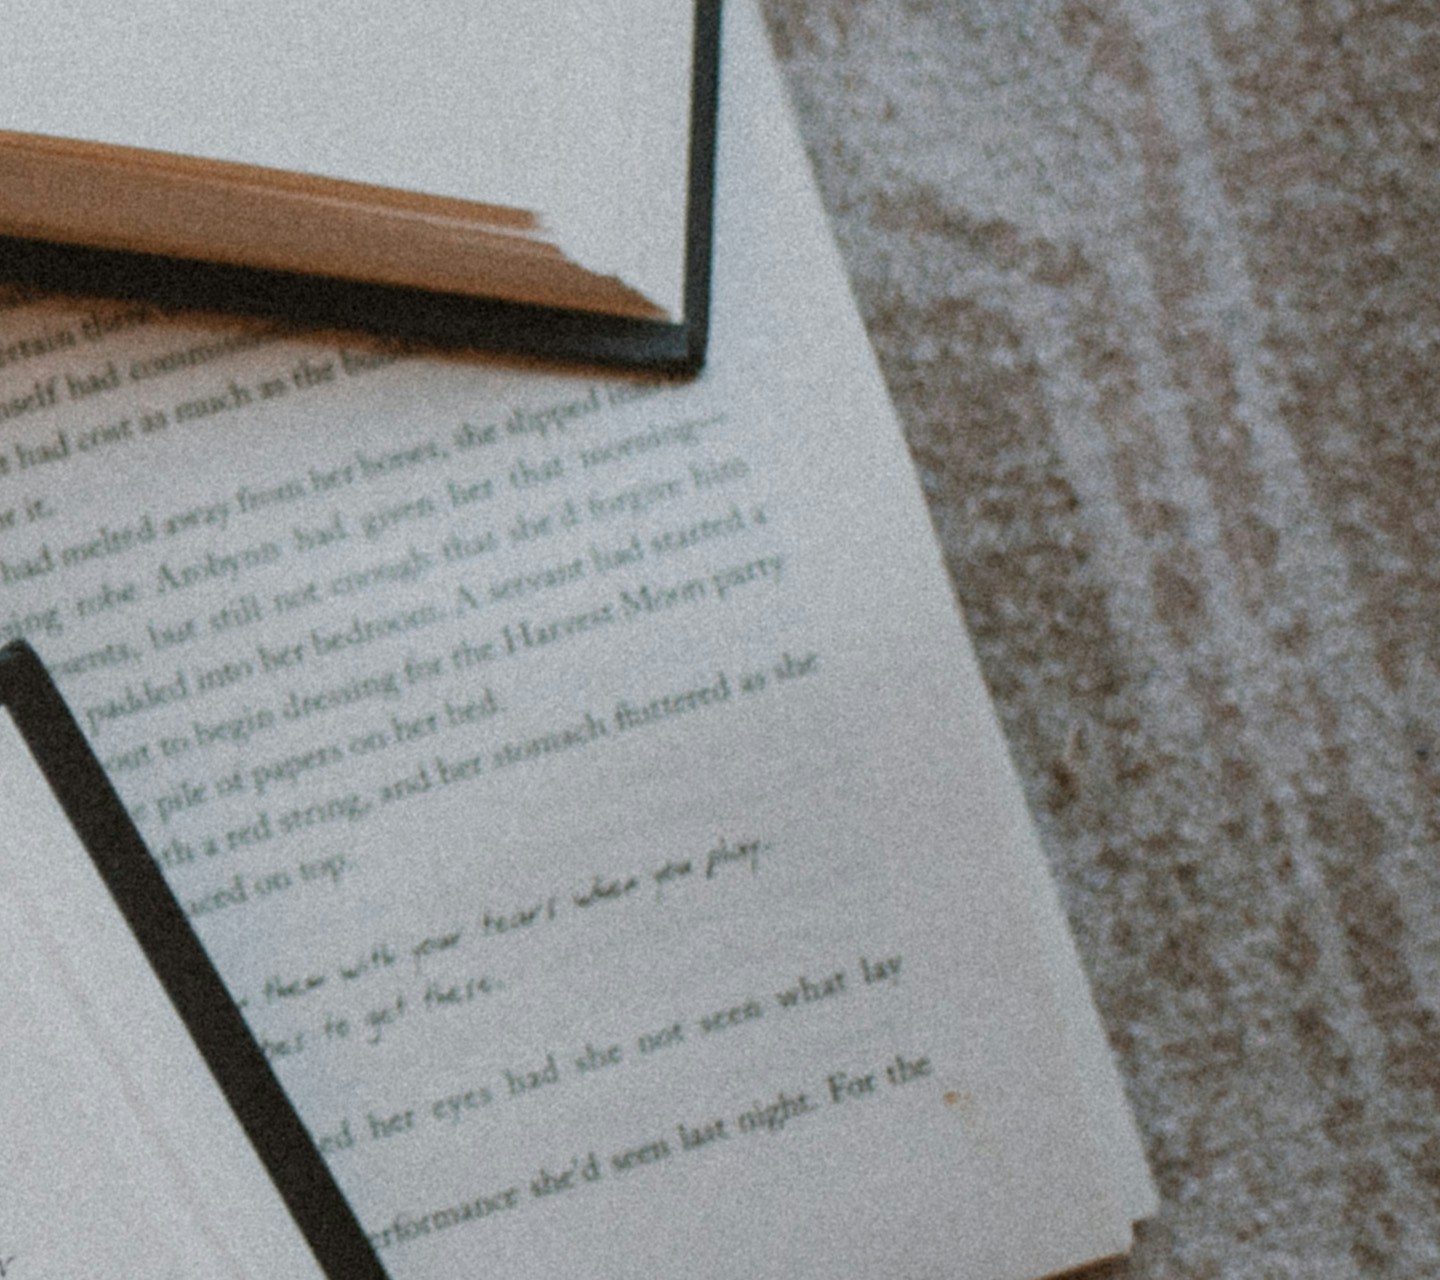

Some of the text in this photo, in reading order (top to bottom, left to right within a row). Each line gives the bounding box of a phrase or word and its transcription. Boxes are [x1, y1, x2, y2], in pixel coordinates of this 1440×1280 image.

[22, 496, 57, 523] it.
[527, 1053, 933, 1200] she’d seen last night. For the
